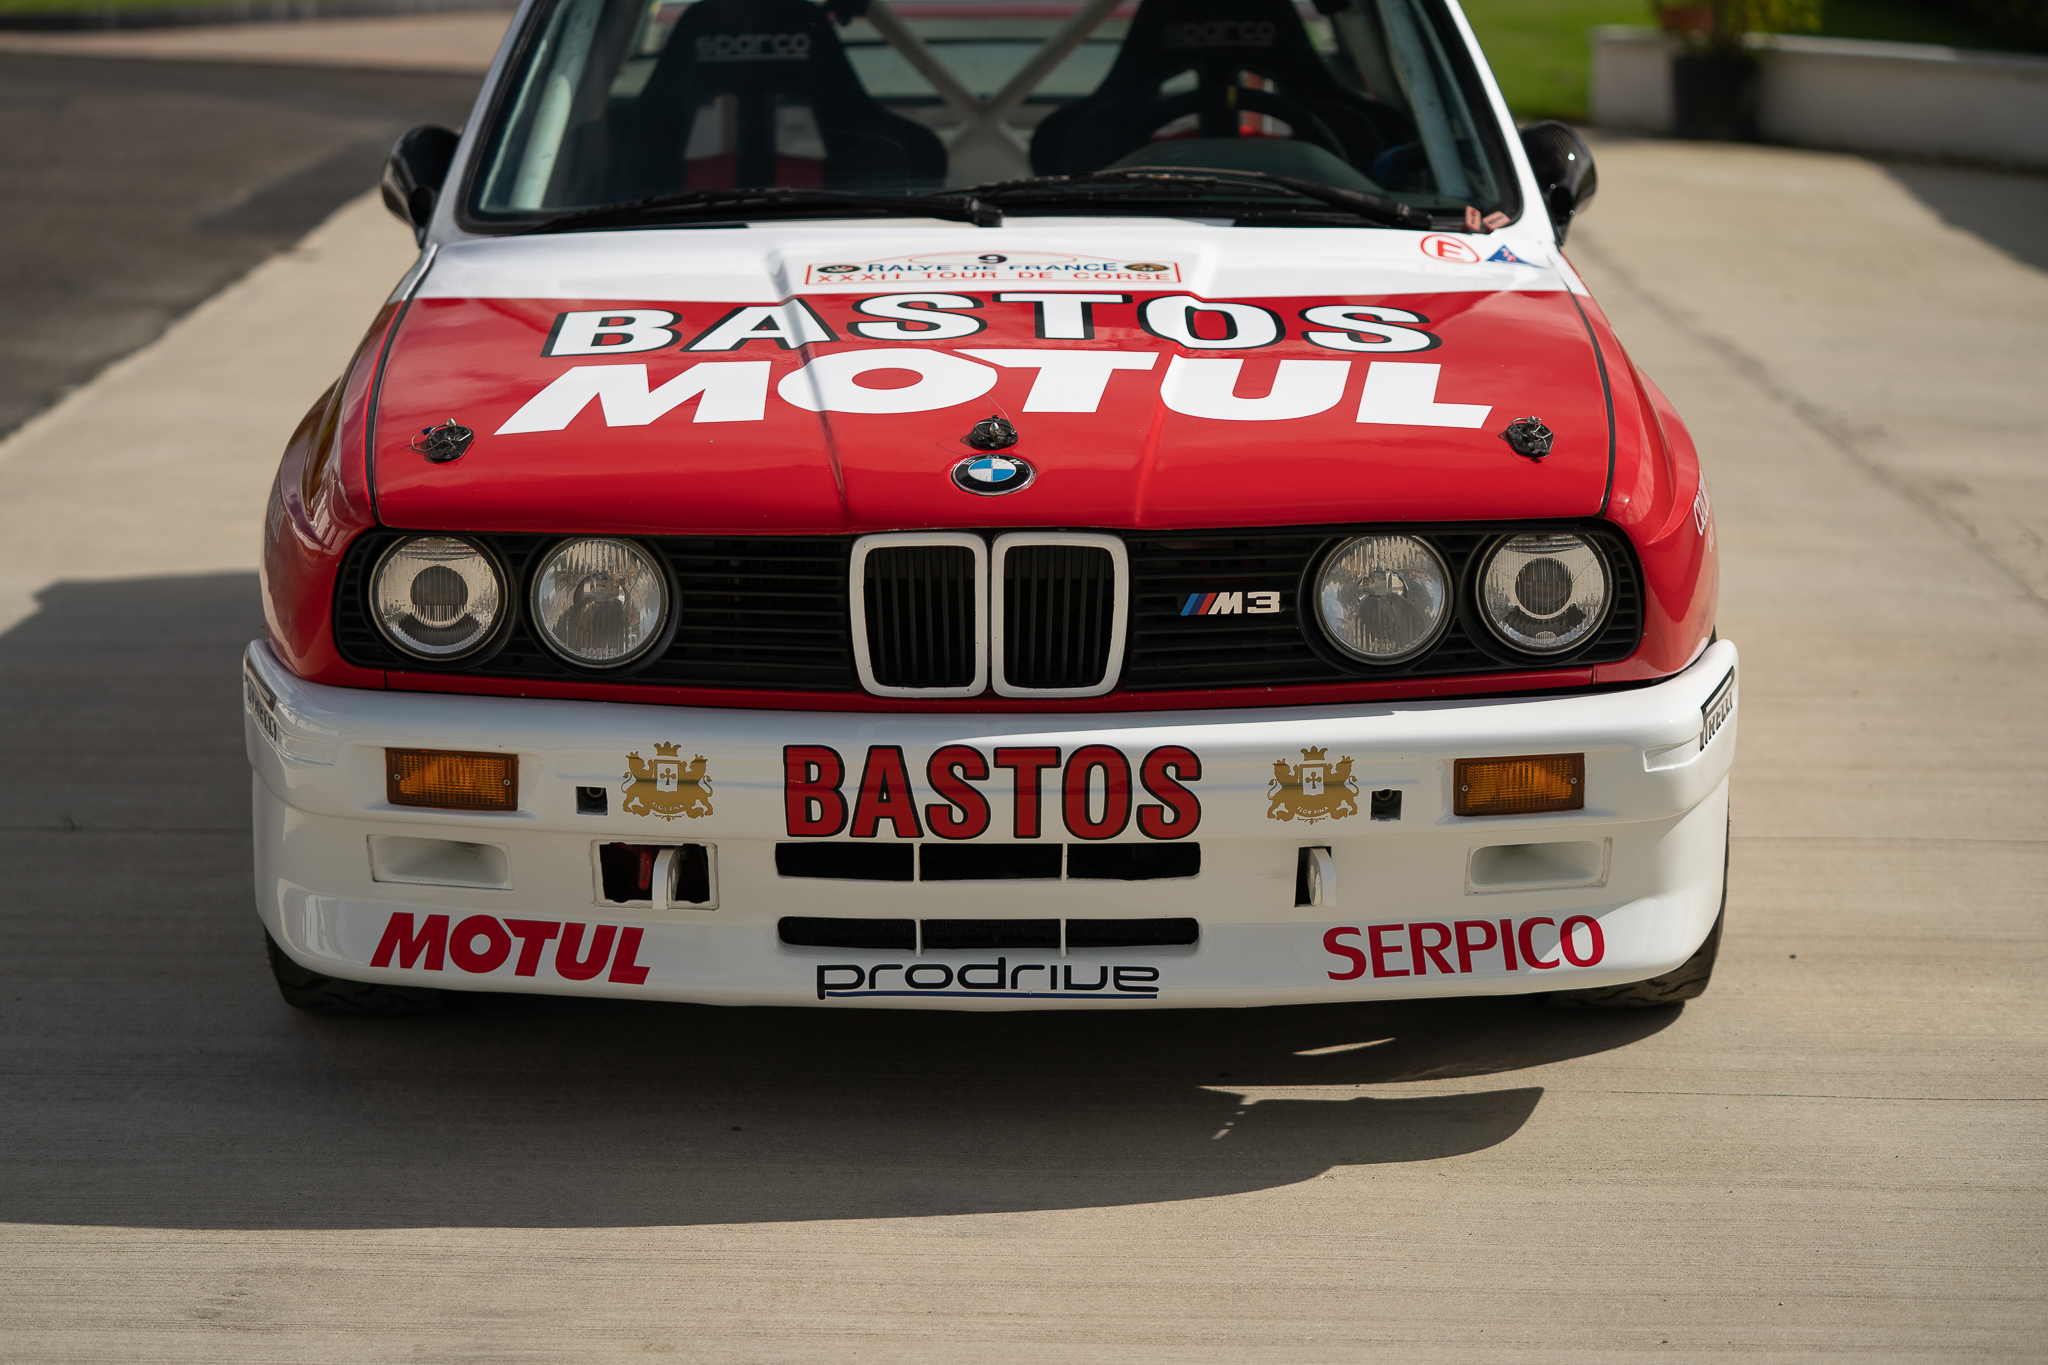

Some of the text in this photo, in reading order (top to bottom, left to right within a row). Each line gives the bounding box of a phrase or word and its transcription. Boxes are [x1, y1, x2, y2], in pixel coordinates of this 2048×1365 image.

[818, 273, 901, 282] XXXII
[922, 272, 998, 280] TOUR
[1073, 272, 1171, 280] CORSE
[868, 264, 951, 272] RALYE
[1009, 262, 1118, 272] FRANCE
[978, 254, 1008, 265] 9
[1436, 239, 1466, 262] E
[540, 292, 1443, 358] BASTOS
[496, 348, 1493, 435] MOTUL
[1208, 591, 1281, 615] M3
[1699, 665, 1736, 753] PIRELLI
[782, 744, 1202, 840] BASTOS
[369, 912, 651, 985] MOTUL
[1322, 914, 1606, 981] SERPICO
[816, 957, 1160, 1000] prodrive
